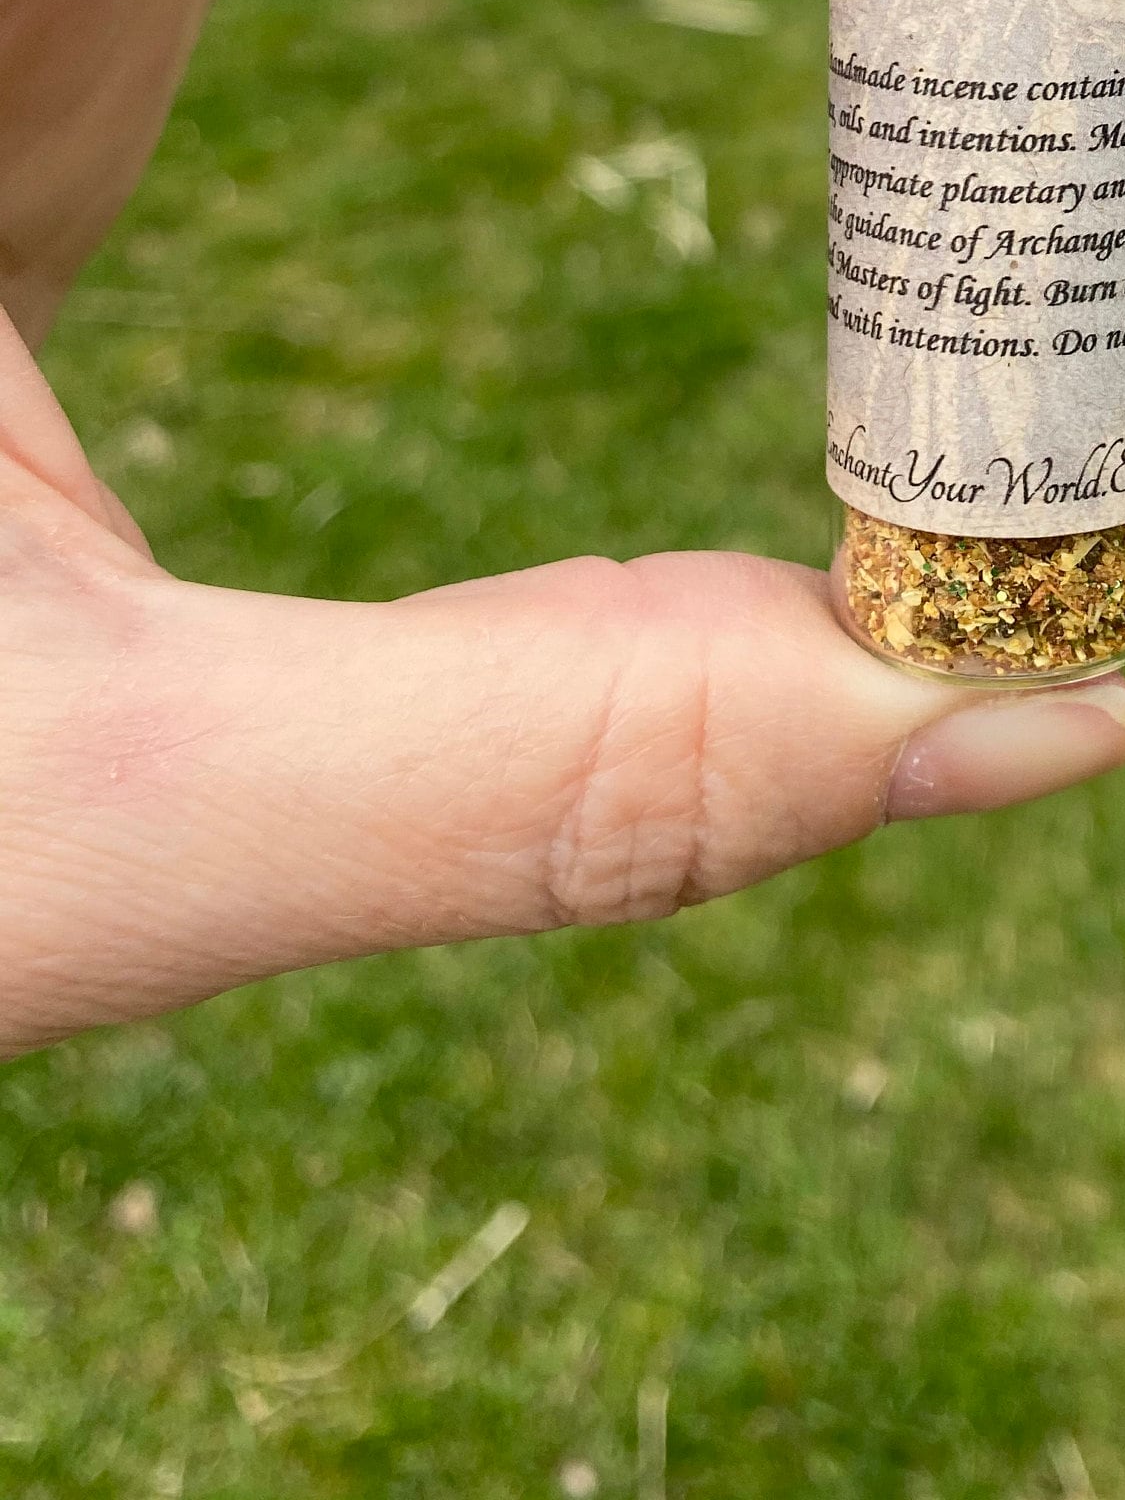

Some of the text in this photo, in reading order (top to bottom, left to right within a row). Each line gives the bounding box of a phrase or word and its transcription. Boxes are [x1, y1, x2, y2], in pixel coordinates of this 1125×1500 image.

[911, 68, 1019, 100] incense
[839, 104, 865, 134] oils
[869, 115, 919, 144] and
[918, 120, 1077, 153] intentions.
[830, 153, 934, 198] appropriate
[938, 172, 1087, 213] planetary
[845, 211, 942, 251] guidance
[950, 224, 989, 264] of
[836, 250, 911, 296] Masters
[917, 273, 955, 311] of
[953, 274, 1032, 317] light.
[1043, 279, 1118, 307] Burn
[842, 307, 883, 341] with
[889, 318, 1040, 357] intentions.
[1052, 328, 1098, 356] Do
